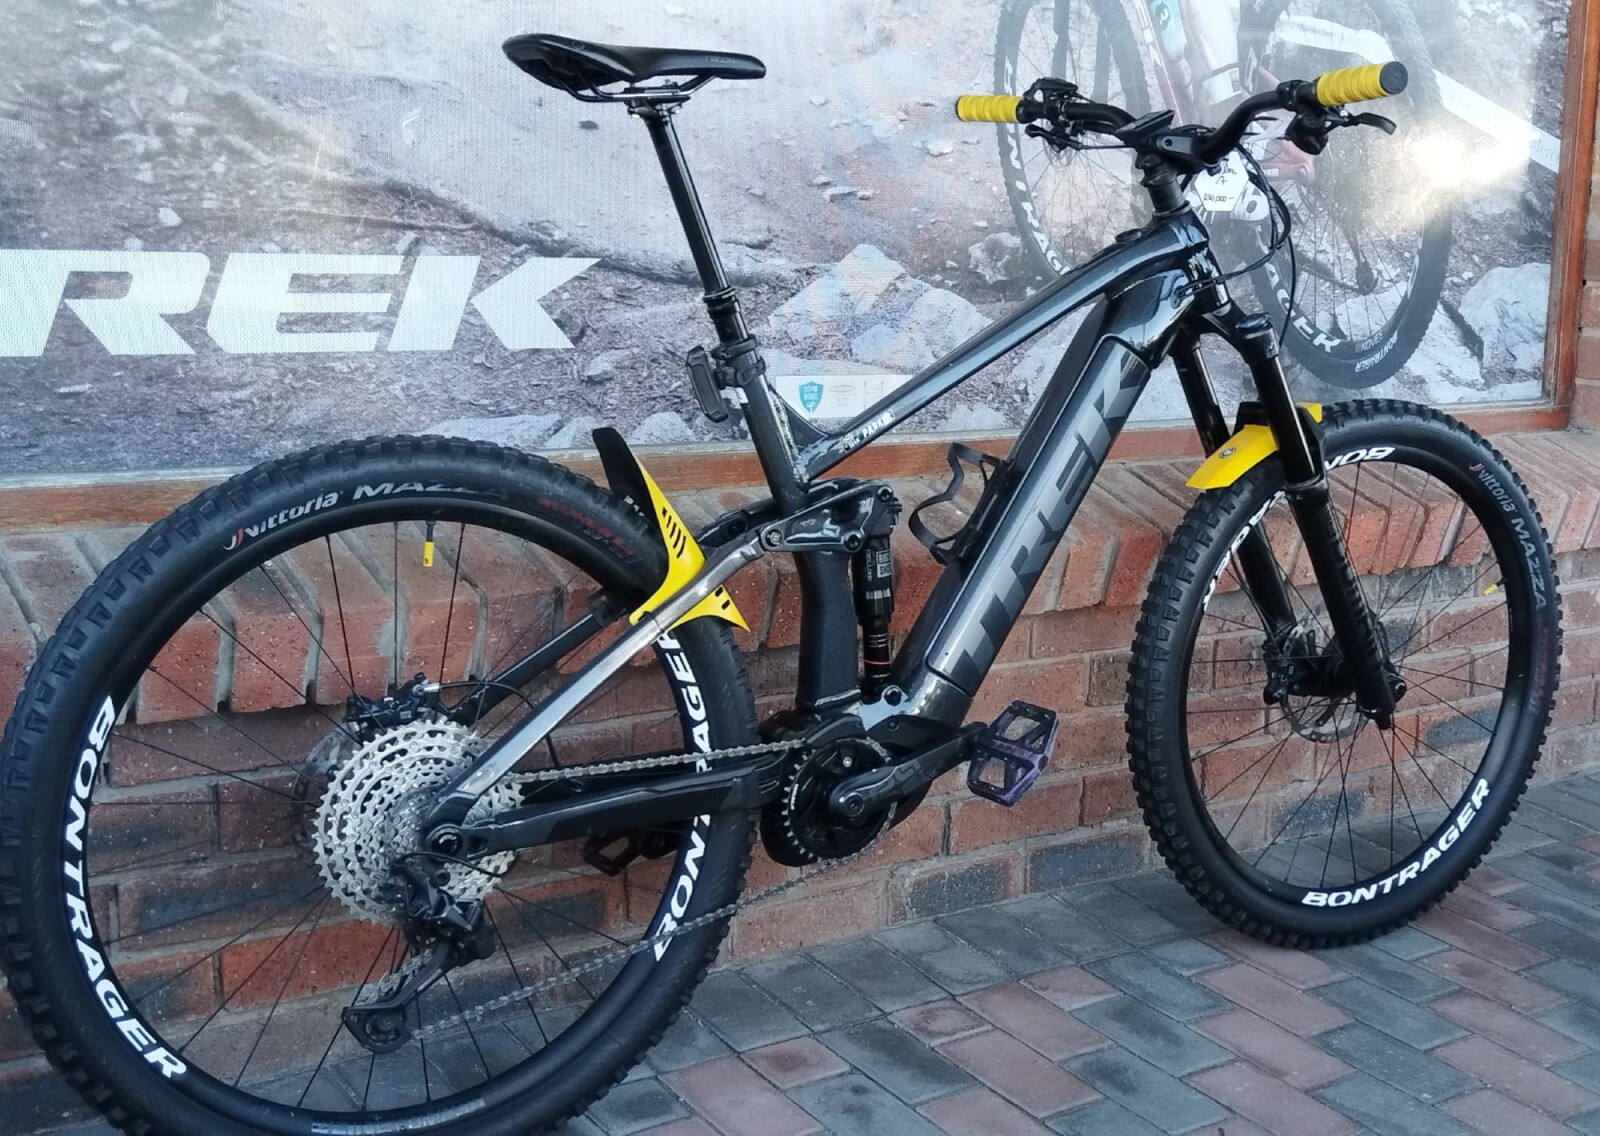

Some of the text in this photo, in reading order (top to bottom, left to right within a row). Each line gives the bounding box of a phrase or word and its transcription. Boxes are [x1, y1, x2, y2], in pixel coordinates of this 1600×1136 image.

[1510, 518, 1547, 612] MAZZA
[62, 695, 188, 1079] BONTRAGER
[1301, 777, 1491, 909] BONTRAGER
